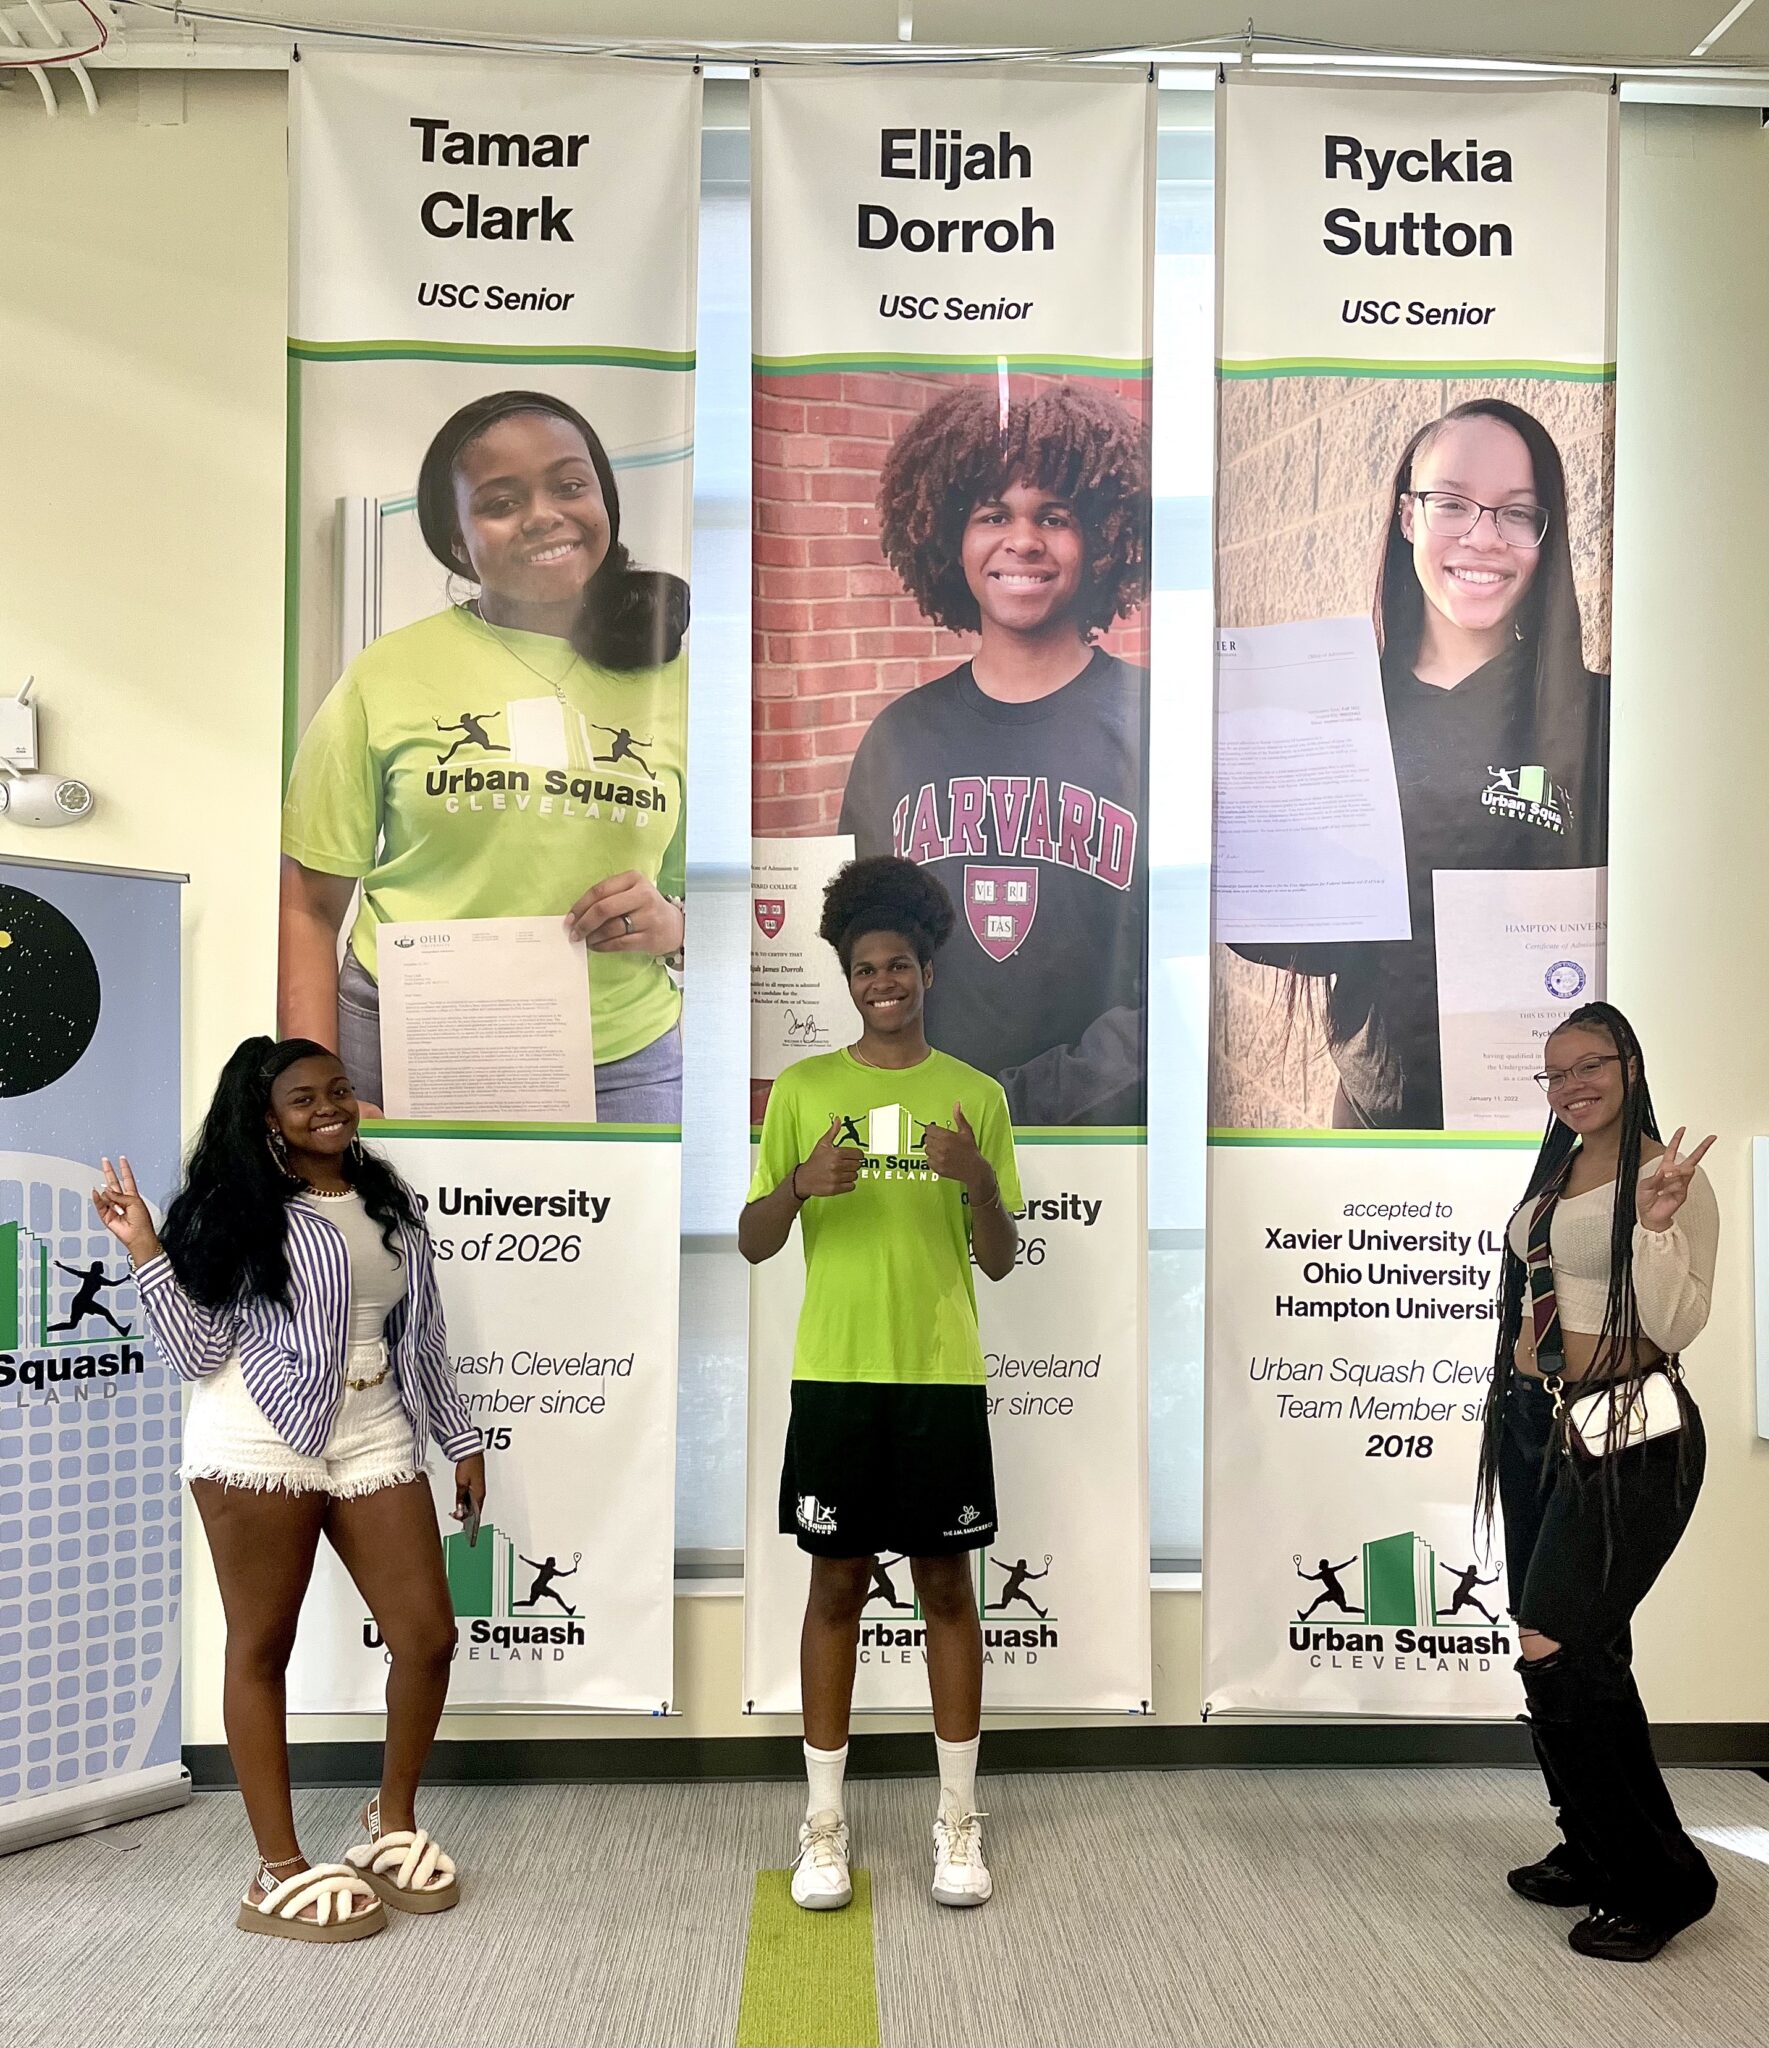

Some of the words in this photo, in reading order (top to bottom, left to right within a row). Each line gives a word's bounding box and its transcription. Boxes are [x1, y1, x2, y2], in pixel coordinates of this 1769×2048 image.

[410, 117, 590, 168] Tamar
[881, 128, 1031, 191] Elijah
[1324, 135, 1513, 191] Ryckia
[420, 191, 575, 242] Clark
[858, 204, 1055, 253] Dorroh
[1323, 207, 1513, 257] Sutton
[417, 282, 479, 308] USC
[484, 286, 575, 311] Senior
[879, 294, 939, 319] USC
[944, 297, 1034, 321] Senior
[1341, 299, 1401, 324] USC
[1405, 301, 1496, 325] Senior
[426, 767, 529, 796] Urban
[544, 770, 667, 812] Squash
[1481, 792, 1526, 812] Urban
[446, 793, 649, 828] CLEVELAND
[976, 884, 993, 897] VE
[1009, 885, 1024, 897] RI
[420, 934, 451, 944] OHIO
[990, 919, 1011, 934] TAS
[1505, 924, 1557, 933] HAMPTON
[781, 965, 804, 973] Dorroh
[861, 1169, 939, 1181] EVELAND
[439, 1187, 611, 1223] University
[1343, 1201, 1432, 1220] accepted
[1435, 1202, 1453, 1218] to
[461, 1233, 493, 1261] of
[496, 1235, 582, 1263] 2026
[1265, 1228, 1342, 1250] Xavier
[1349, 1229, 1472, 1256] University
[1303, 1262, 1362, 1284] Ohio
[1368, 1263, 1491, 1290] University
[1275, 1296, 1390, 1322] Hampton
[0, 1344, 145, 1390] Squash
[511, 1352, 635, 1377] Cleveland
[984, 1353, 1102, 1378] Cleveland
[1250, 1357, 1323, 1381] Urban
[1330, 1357, 1425, 1387] Squash
[17, 1381, 118, 1408] LAND
[540, 1389, 606, 1414] since
[1009, 1392, 1074, 1416] since
[1276, 1394, 1342, 1419] Team
[1349, 1395, 1457, 1421] Member
[1365, 1434, 1434, 1458] 2018
[470, 1619, 585, 1648] Squash
[985, 1624, 1058, 1648] uash
[1289, 1627, 1384, 1652] Urban
[1395, 1628, 1510, 1659] Squash
[384, 1648, 565, 1664] CELAND
[1310, 1655, 1491, 1672] CLEVELAND
